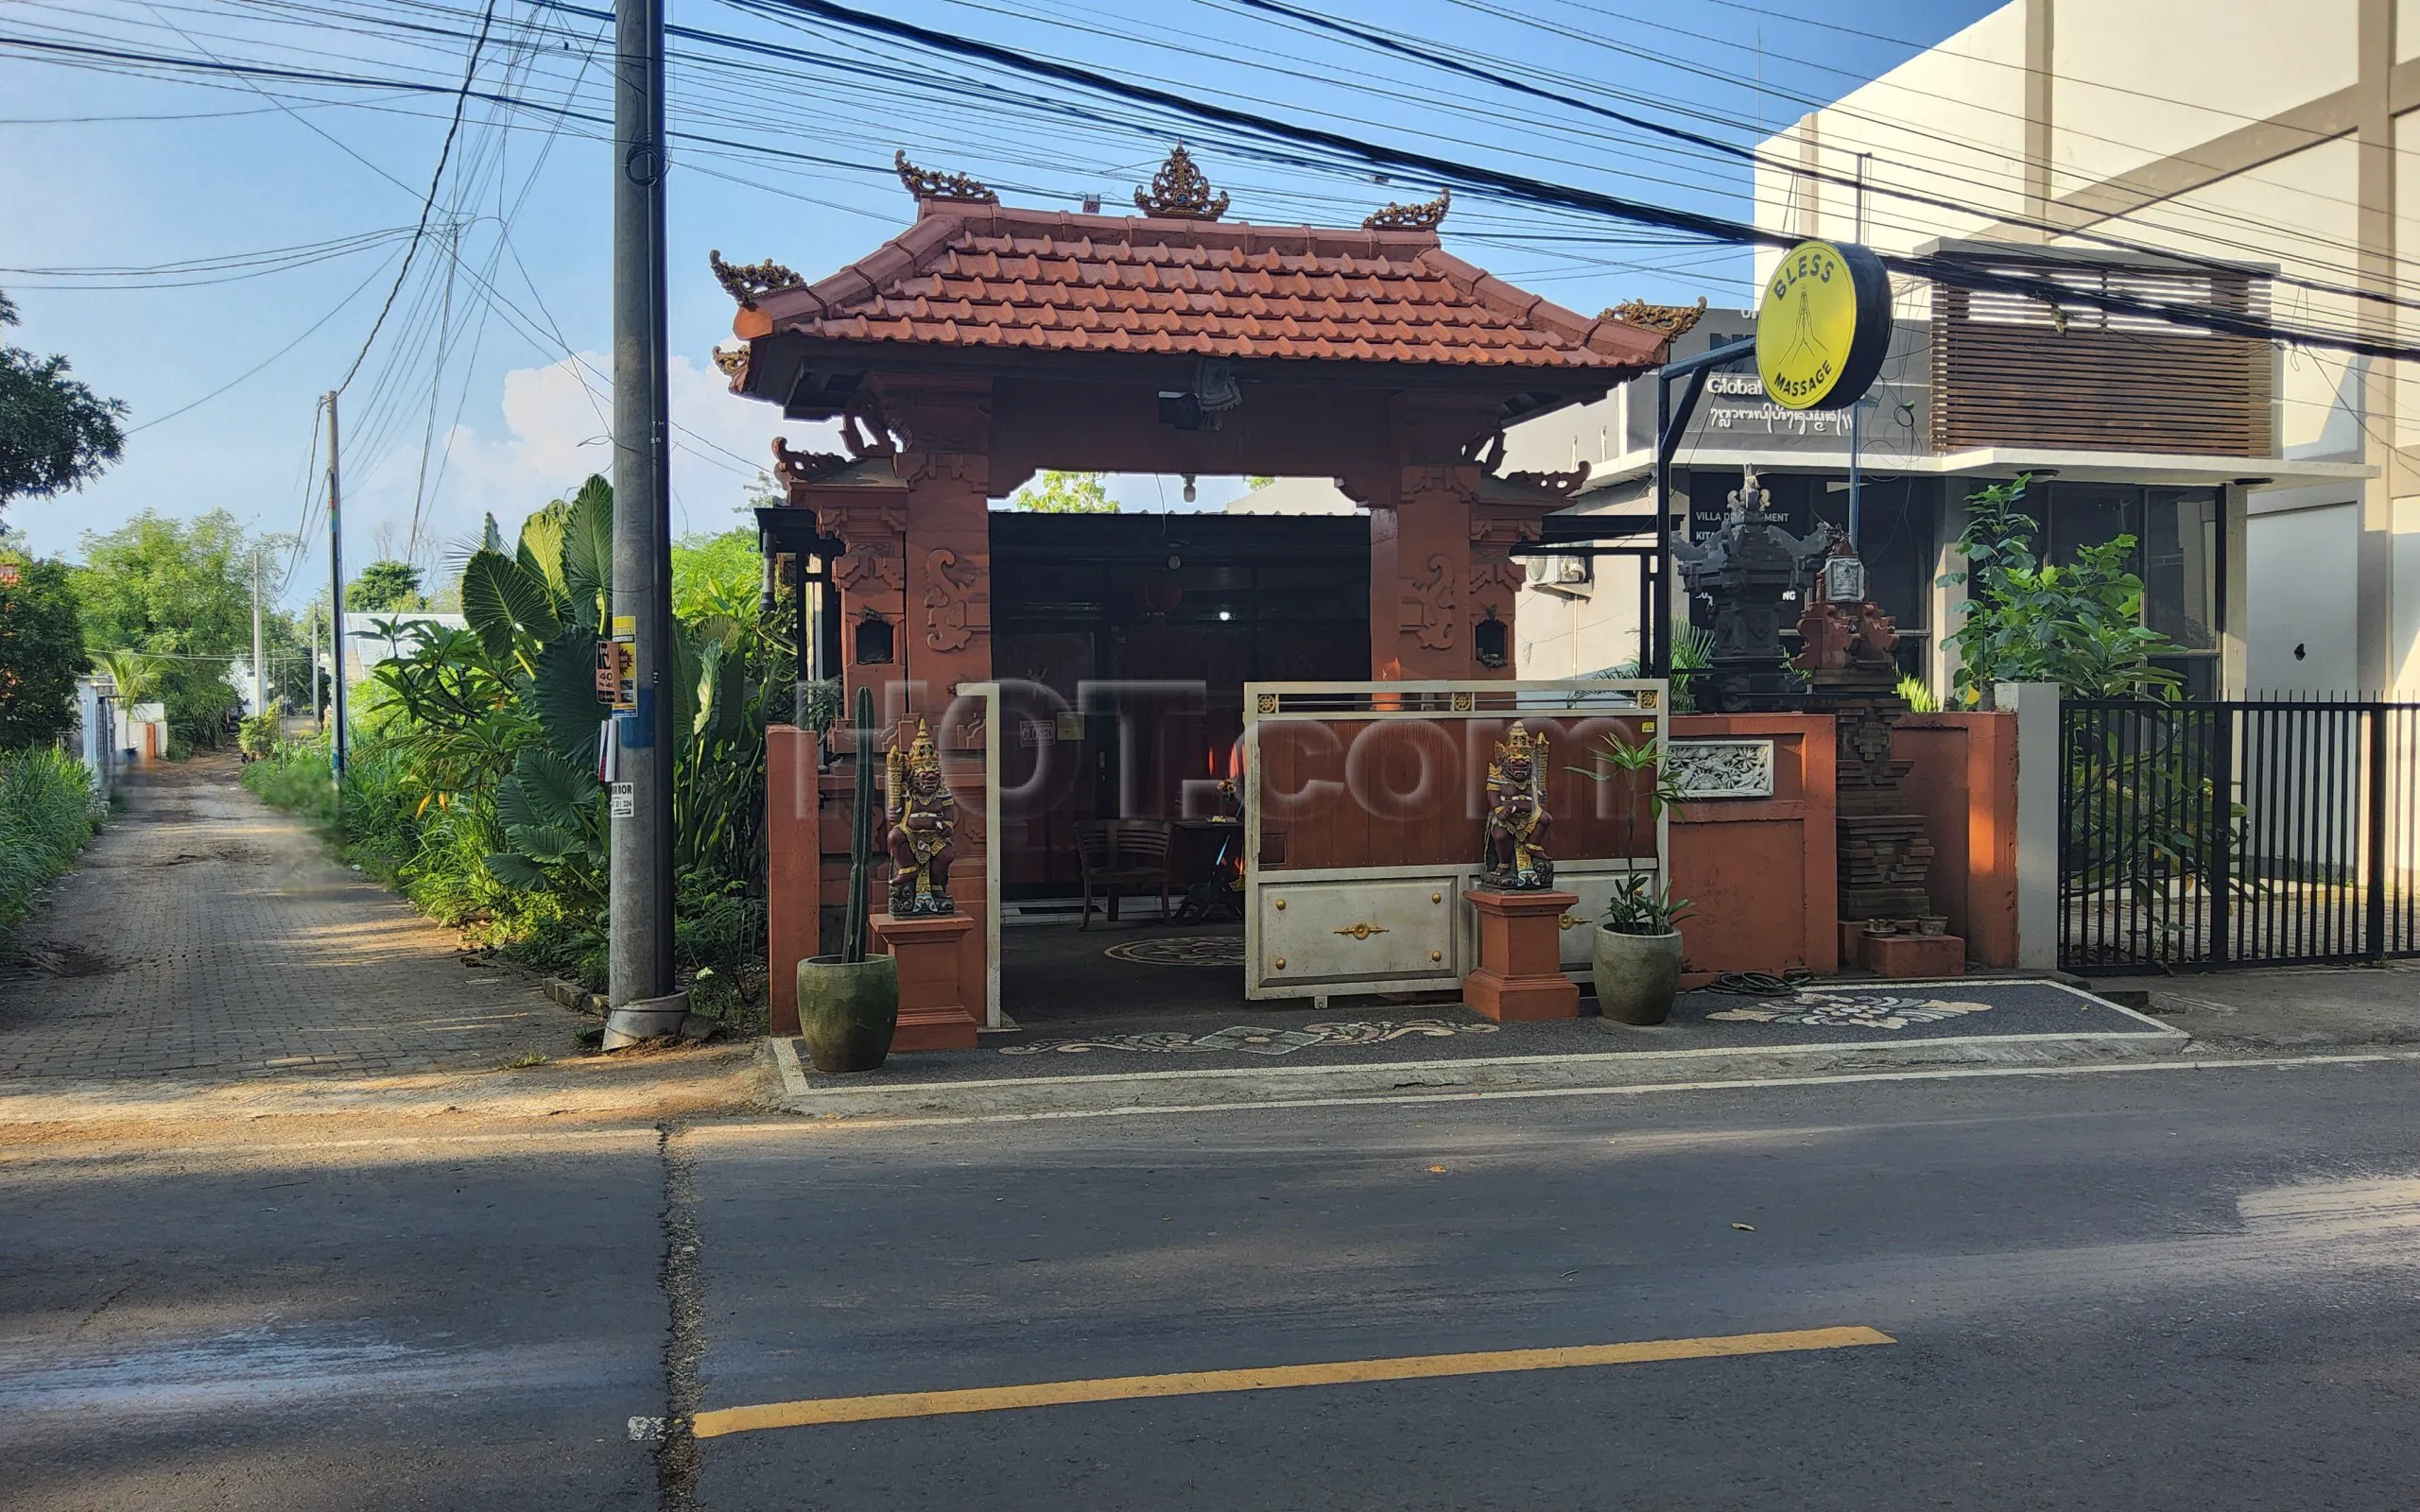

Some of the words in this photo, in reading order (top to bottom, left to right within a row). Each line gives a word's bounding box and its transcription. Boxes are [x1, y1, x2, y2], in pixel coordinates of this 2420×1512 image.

[1772, 253, 1834, 301] BLESS
[1706, 378, 1763, 395] Global
[1773, 359, 1833, 397] MASSAGE
[1695, 511, 1721, 522] VILLA
[1022, 726, 1053, 741] CLOSED
